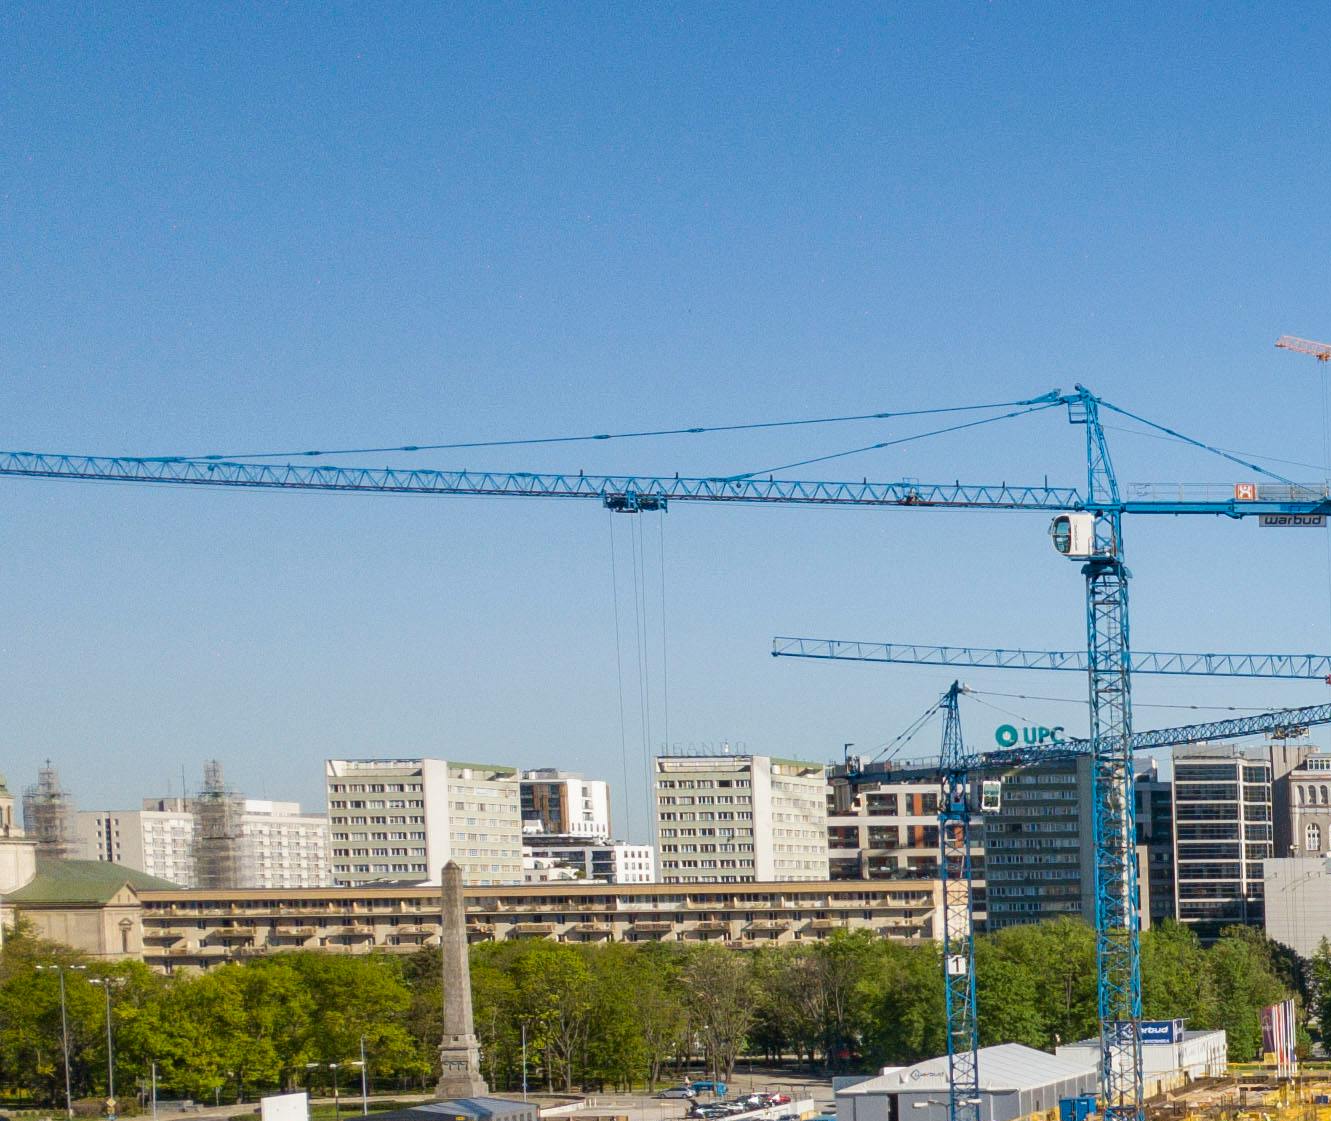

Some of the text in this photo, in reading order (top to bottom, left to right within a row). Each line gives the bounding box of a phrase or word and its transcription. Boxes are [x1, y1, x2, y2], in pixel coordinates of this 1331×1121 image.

[1264, 515, 1322, 525] warbud
[1023, 726, 1065, 744] UPC
[952, 957, 959, 972] 1
